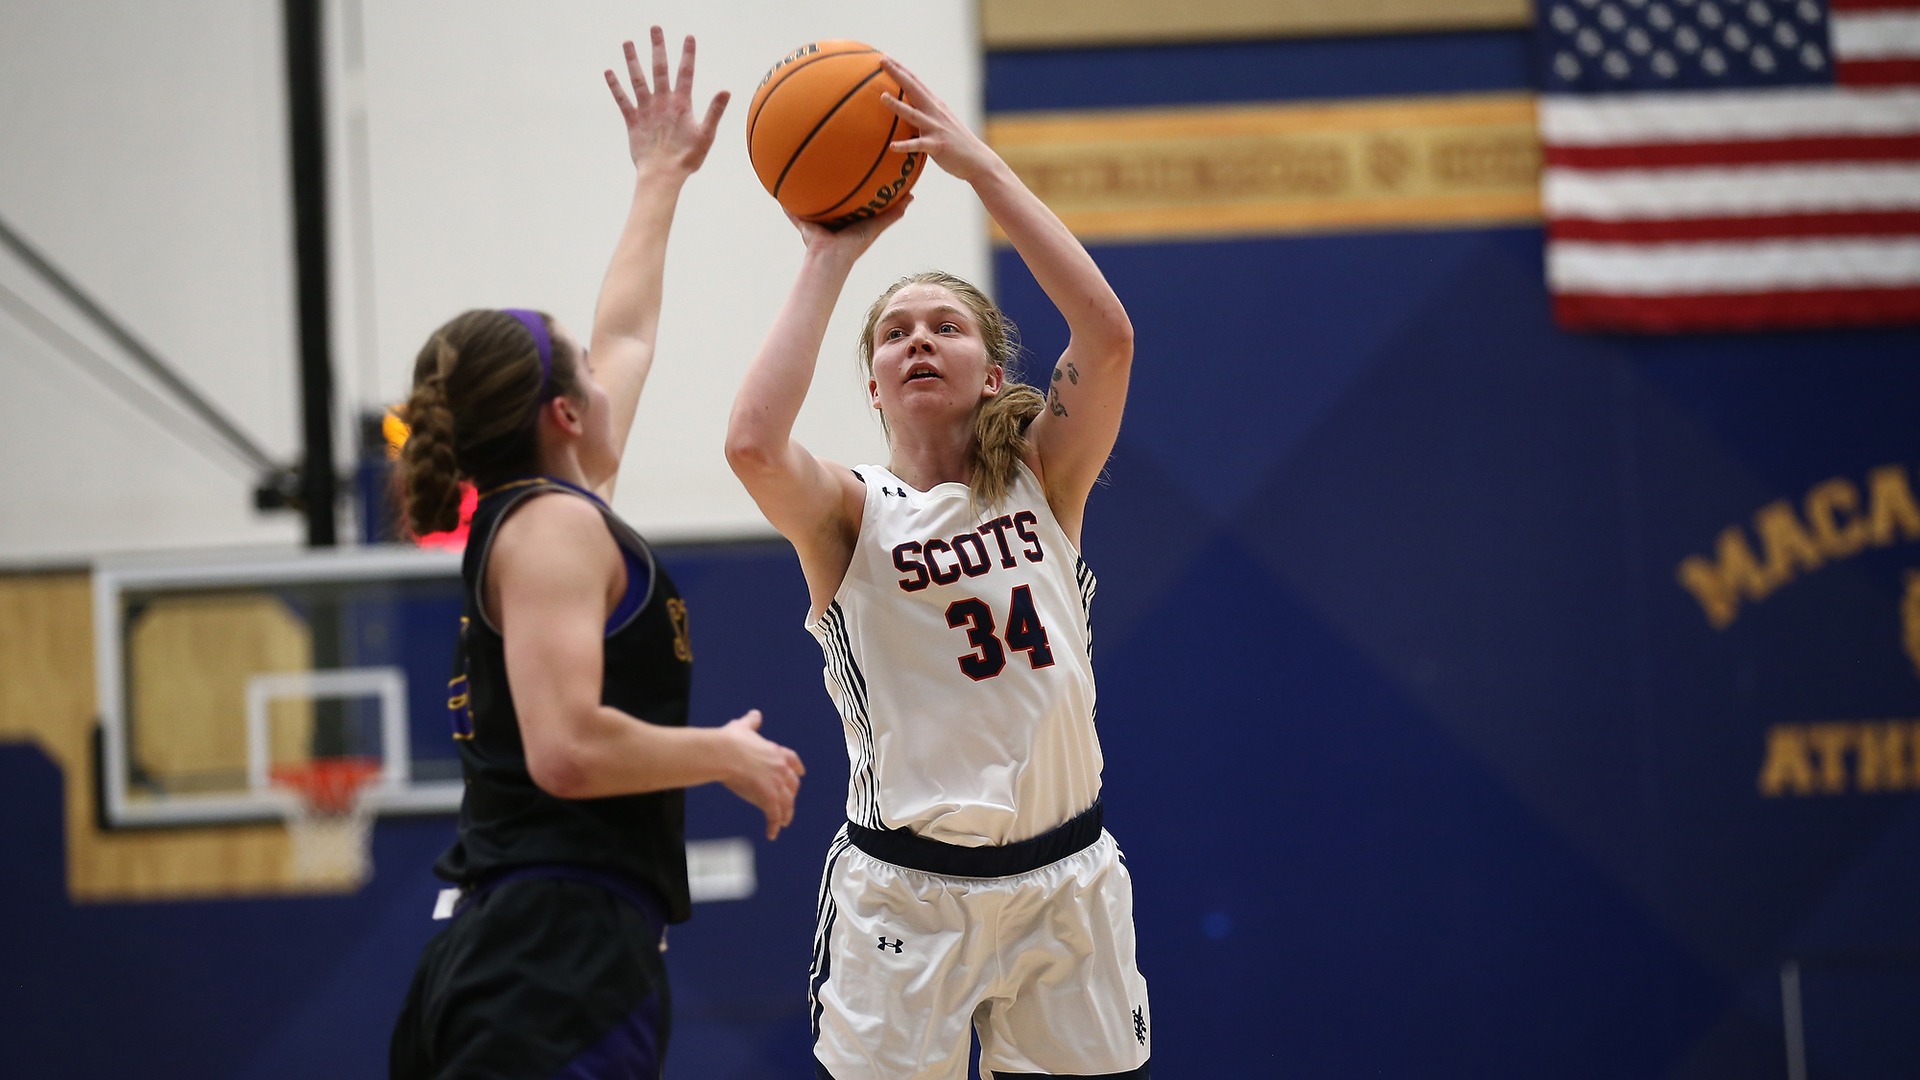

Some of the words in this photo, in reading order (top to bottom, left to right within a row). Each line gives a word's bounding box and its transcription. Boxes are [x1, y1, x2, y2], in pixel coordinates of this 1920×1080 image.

[891, 510, 1045, 593] SCOTS
[944, 583, 1056, 682] 34
[1757, 717, 1920, 797] ATH
